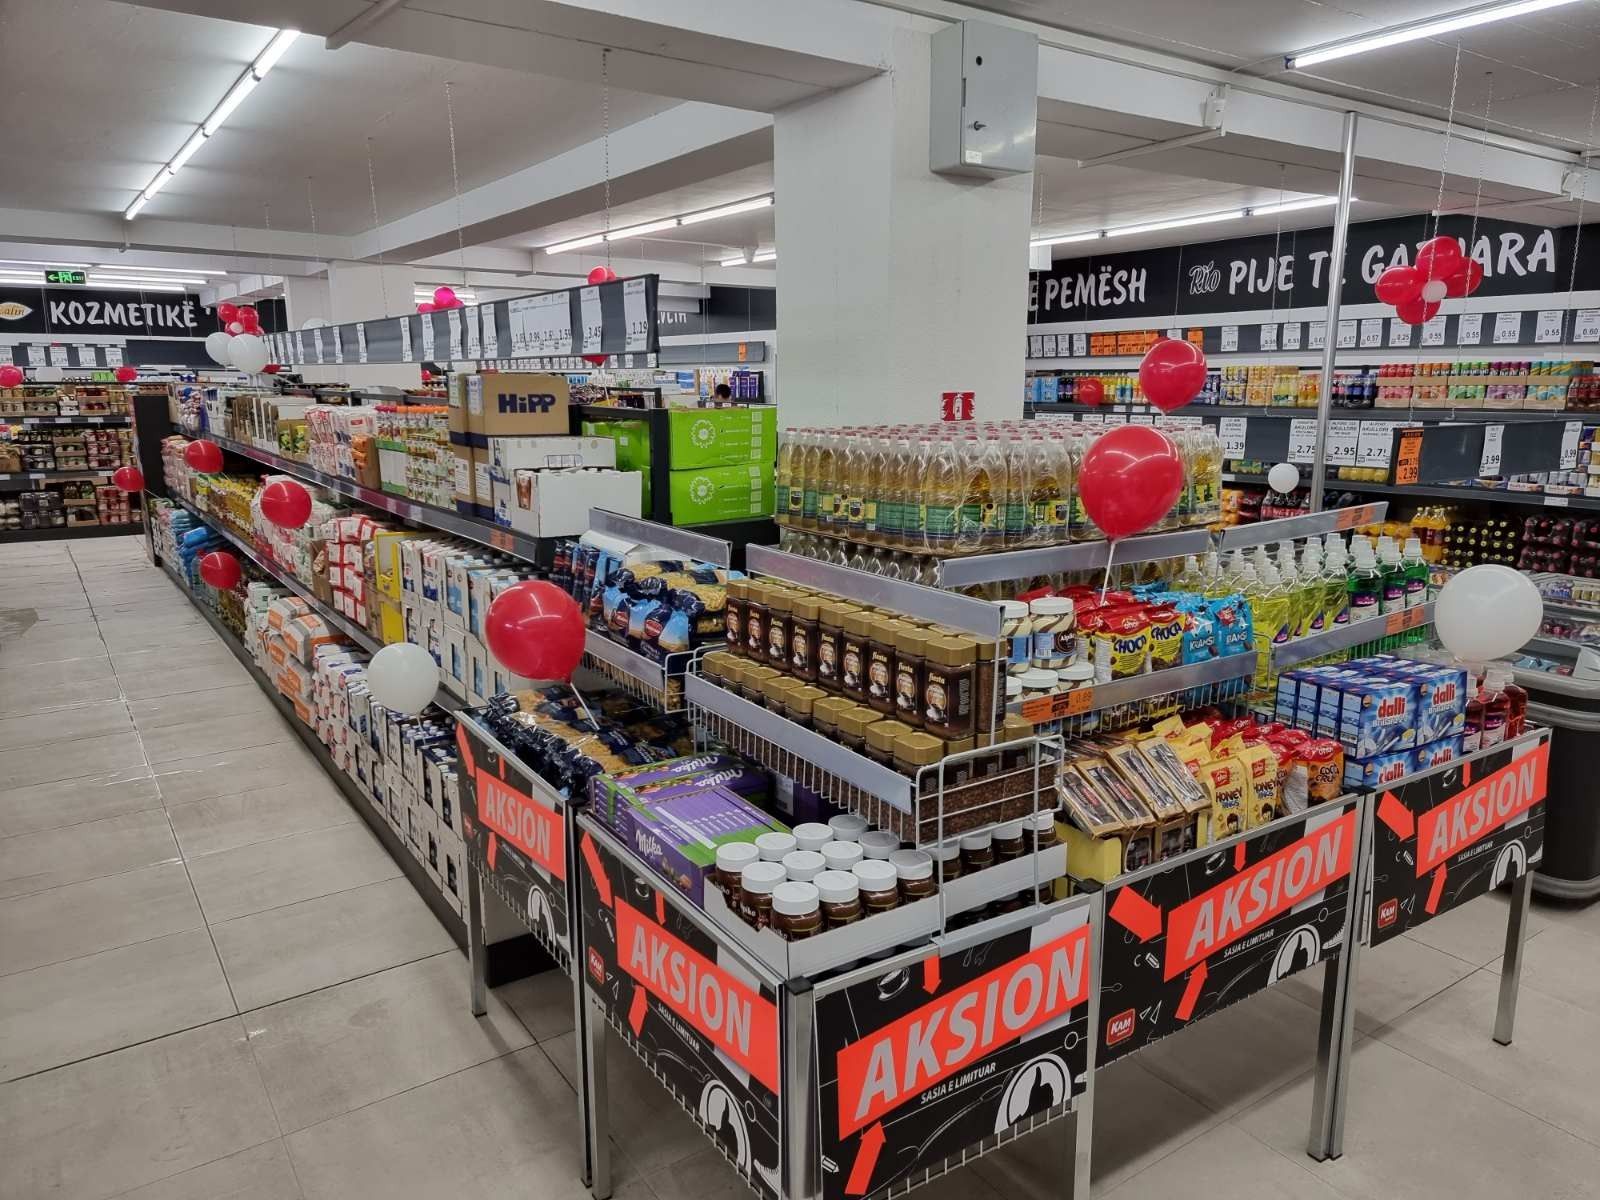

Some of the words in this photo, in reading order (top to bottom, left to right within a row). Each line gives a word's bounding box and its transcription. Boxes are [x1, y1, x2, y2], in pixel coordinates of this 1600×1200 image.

[1229, 255, 1295, 295] PIJE
[1361, 229, 1556, 285] GAARA
[1045, 265, 1147, 311] PEMËSH
[49, 300, 198, 328] KOZMETIKË
[632, 321, 648, 335] 1.19
[1544, 328, 1560, 336] 0.55
[498, 393, 556, 413] HiPP
[1226, 441, 1244, 450] 1.39
[1334, 446, 1355, 455] 2.95
[1378, 696, 1406, 718] dalli
[1433, 683, 1456, 705] dalli
[1215, 786, 1242, 802] HONEY
[485, 783, 551, 862] AKSION
[1427, 757, 1537, 862] AKSION
[636, 828, 663, 857] Milka
[1184, 824, 1344, 961] AKSION
[630, 923, 751, 1056] AKSION
[854, 937, 1086, 1122] AKSION
[1110, 1016, 1131, 1036] KAM
[920, 1084, 947, 1105] SASIA
[947, 1082, 954, 1093] E
[954, 1062, 996, 1090] LIMITUAR
